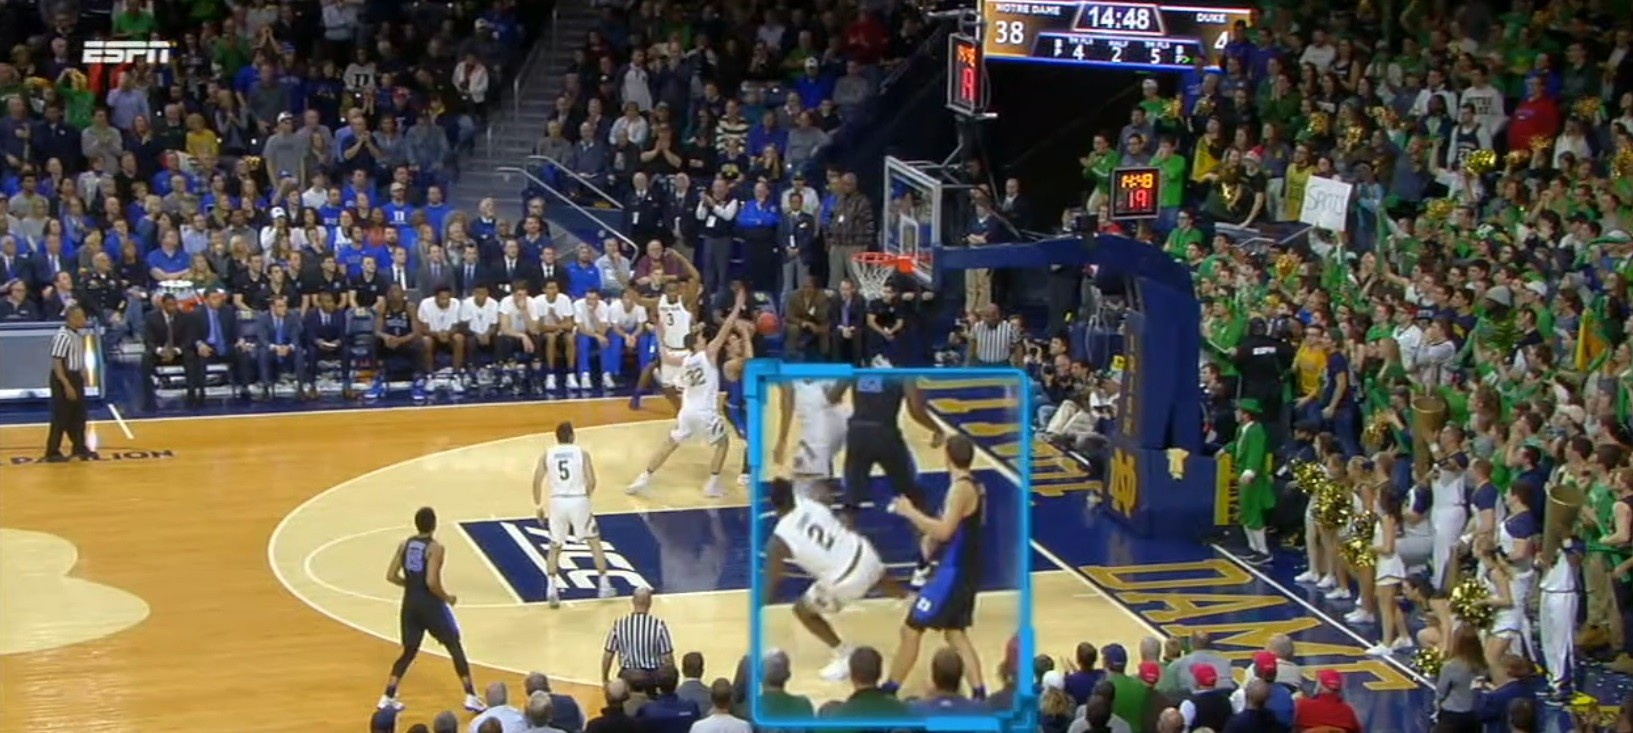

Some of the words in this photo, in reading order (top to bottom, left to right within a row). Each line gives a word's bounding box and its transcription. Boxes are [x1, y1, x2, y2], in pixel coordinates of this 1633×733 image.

[1032, 5, 1061, 16] DAME
[1088, 5, 1150, 29] 14:48
[1196, 13, 1227, 23] DUKE
[995, 20, 1025, 44] 38
[1072, 44, 1086, 60] 4
[1111, 46, 1123, 62] 2
[1150, 48, 1161, 64] 5
[1129, 189, 1148, 208] 19
[665, 312, 675, 327] 3
[685, 366, 707, 387] 32
[557, 459, 570, 481] 5
[806, 523, 834, 552] 2
